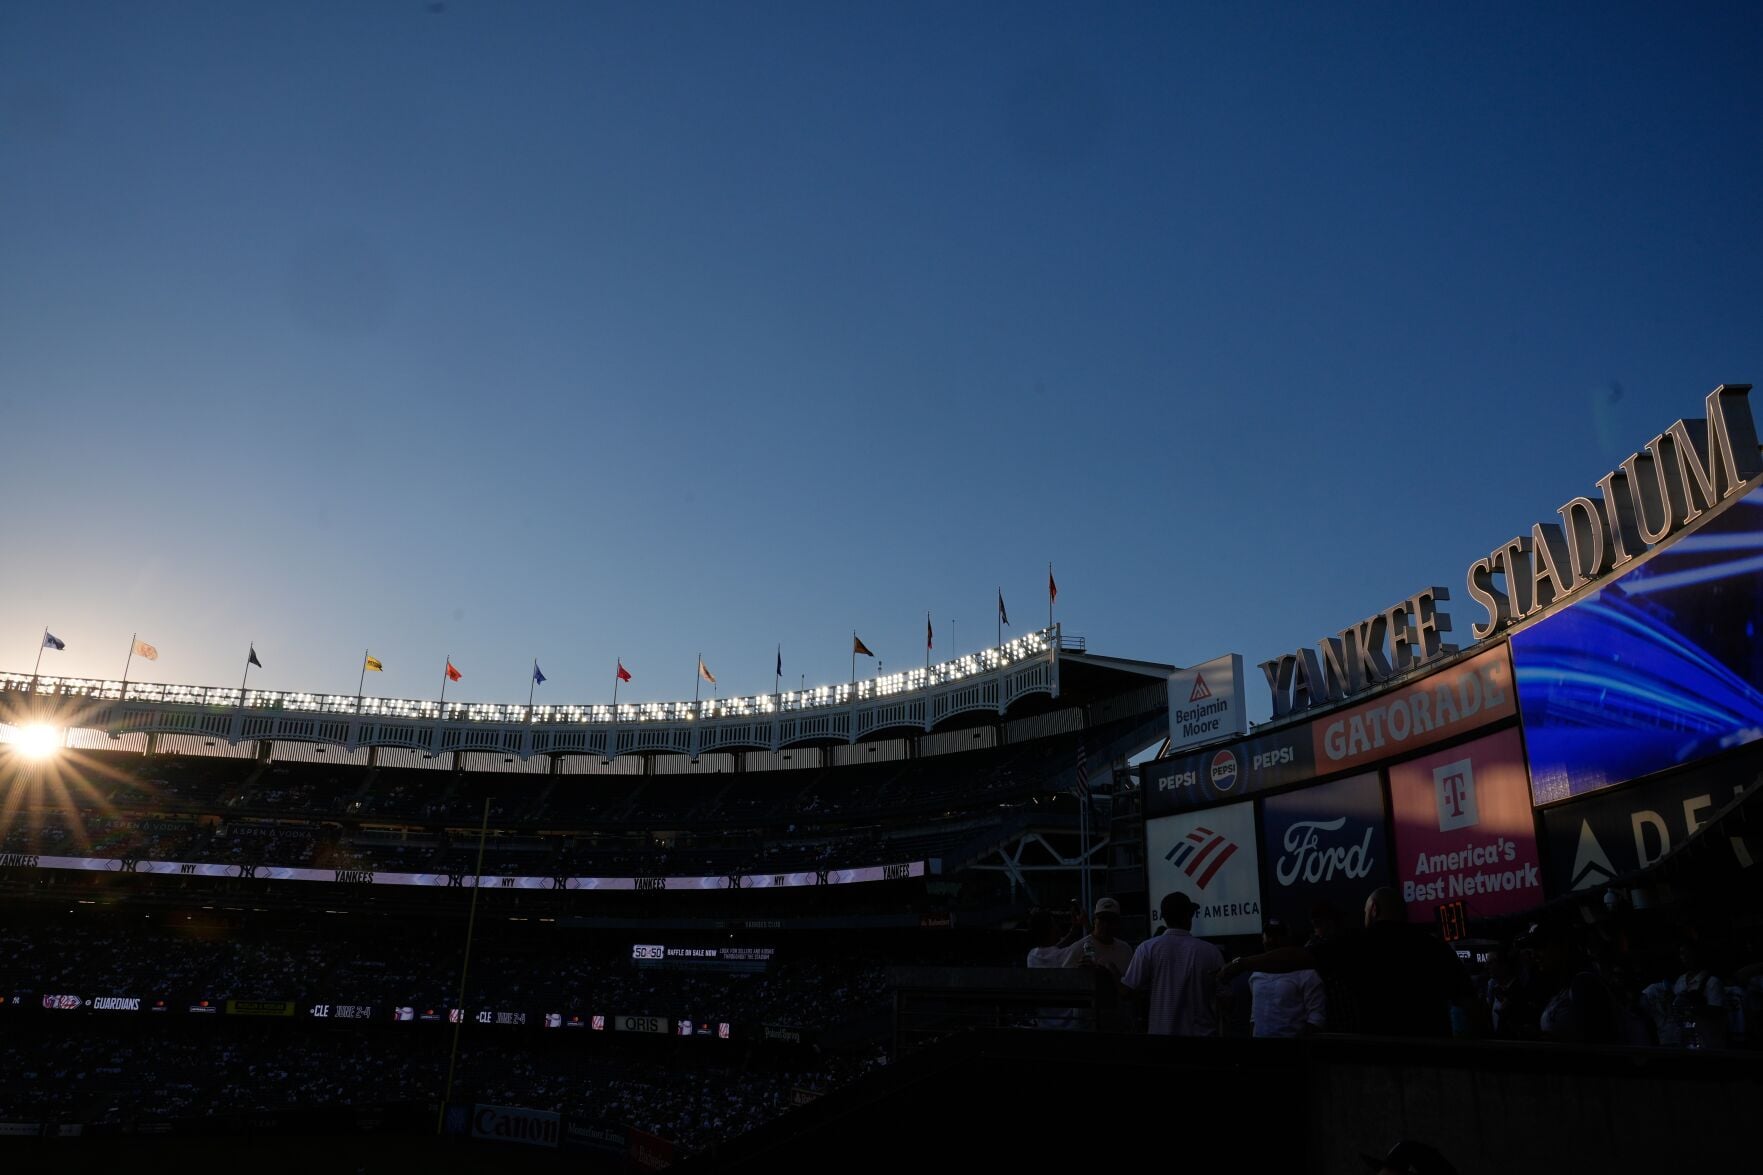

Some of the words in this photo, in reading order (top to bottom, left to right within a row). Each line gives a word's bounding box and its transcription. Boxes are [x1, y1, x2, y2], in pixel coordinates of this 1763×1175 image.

[1258, 587, 1455, 718] YANKEE
[1466, 384, 1755, 640] STADIUM
[1176, 699, 1227, 724] Benjamin
[1324, 661, 1505, 761] GATORADE
[1183, 719, 1219, 738] Moore
[1253, 746, 1294, 771] PEPSI
[1212, 763, 1236, 777] PEPSI
[1159, 771, 1196, 792] PEPSI
[1276, 816, 1374, 887] Ford
[1415, 837, 1516, 876] America's
[180, 864, 196, 874] NYY
[882, 864, 910, 880] YANKEES
[335, 870, 374, 885] YANKEES
[502, 878, 515, 887] NYY
[634, 877, 666, 890] YANKEES
[1403, 876, 1445, 903] Best
[1448, 862, 1540, 898] Network
[1204, 902, 1260, 918] AMERICA
[93, 997, 141, 1011] GUARDIANS
[314, 1005, 330, 1018] CLE
[479, 1011, 492, 1024] CLE
[625, 1017, 658, 1032] ORIS
[475, 1109, 558, 1146] Canon
